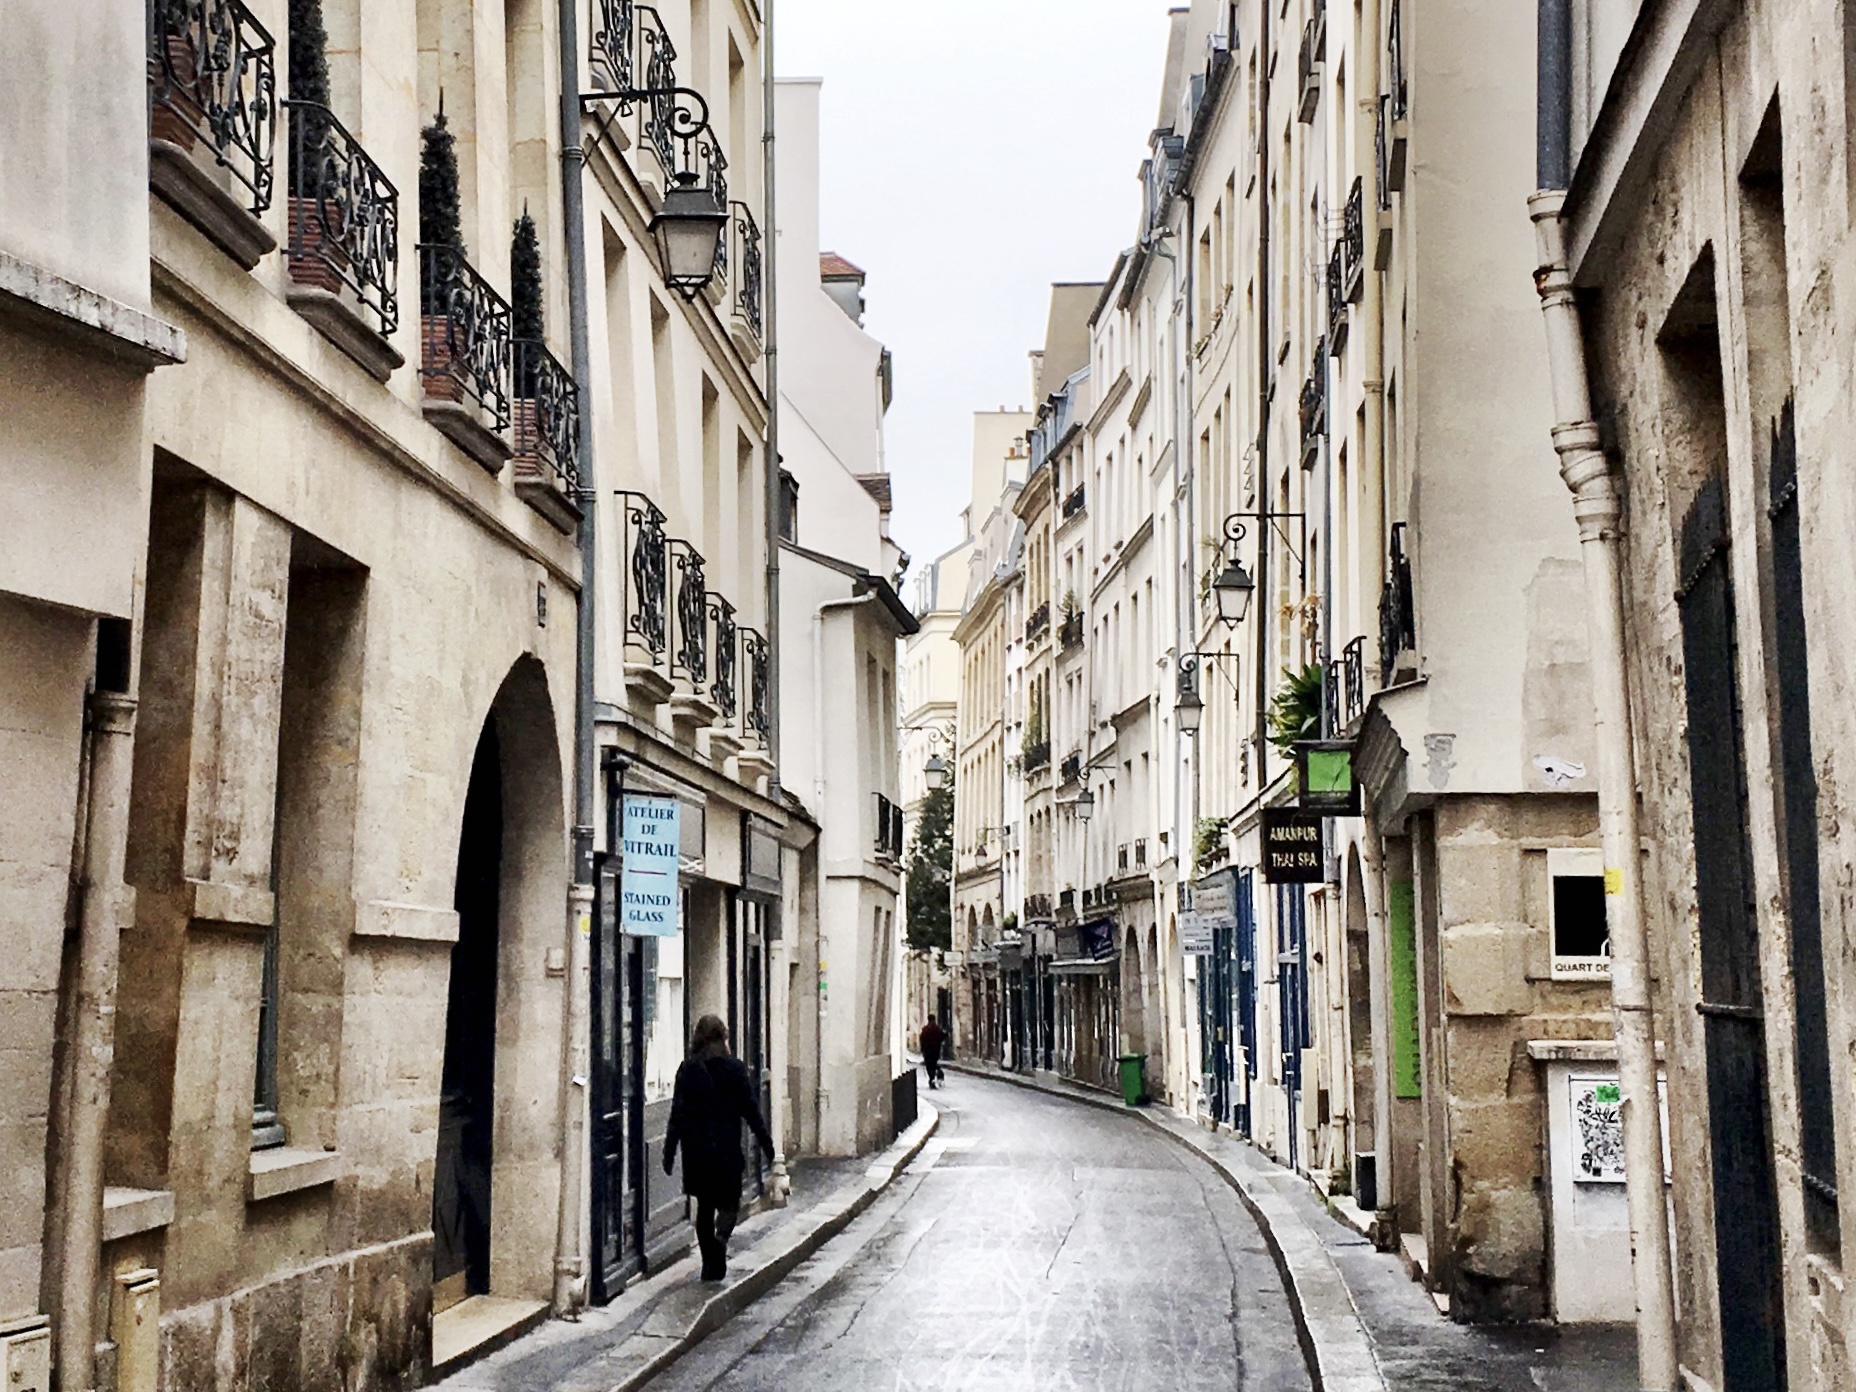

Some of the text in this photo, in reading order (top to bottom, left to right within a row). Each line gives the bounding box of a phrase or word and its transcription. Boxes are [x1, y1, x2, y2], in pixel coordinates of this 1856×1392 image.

[628, 805, 674, 820] ATELIER
[641, 824, 658, 836] DE
[1270, 826, 1318, 842] AMANPUR
[624, 840, 677, 857] VITRAIL
[1272, 852, 1318, 868] THAI SPA
[624, 891, 671, 906] STAINED
[629, 909, 664, 923] GLASS
[1555, 963, 1610, 972] QUART DE
